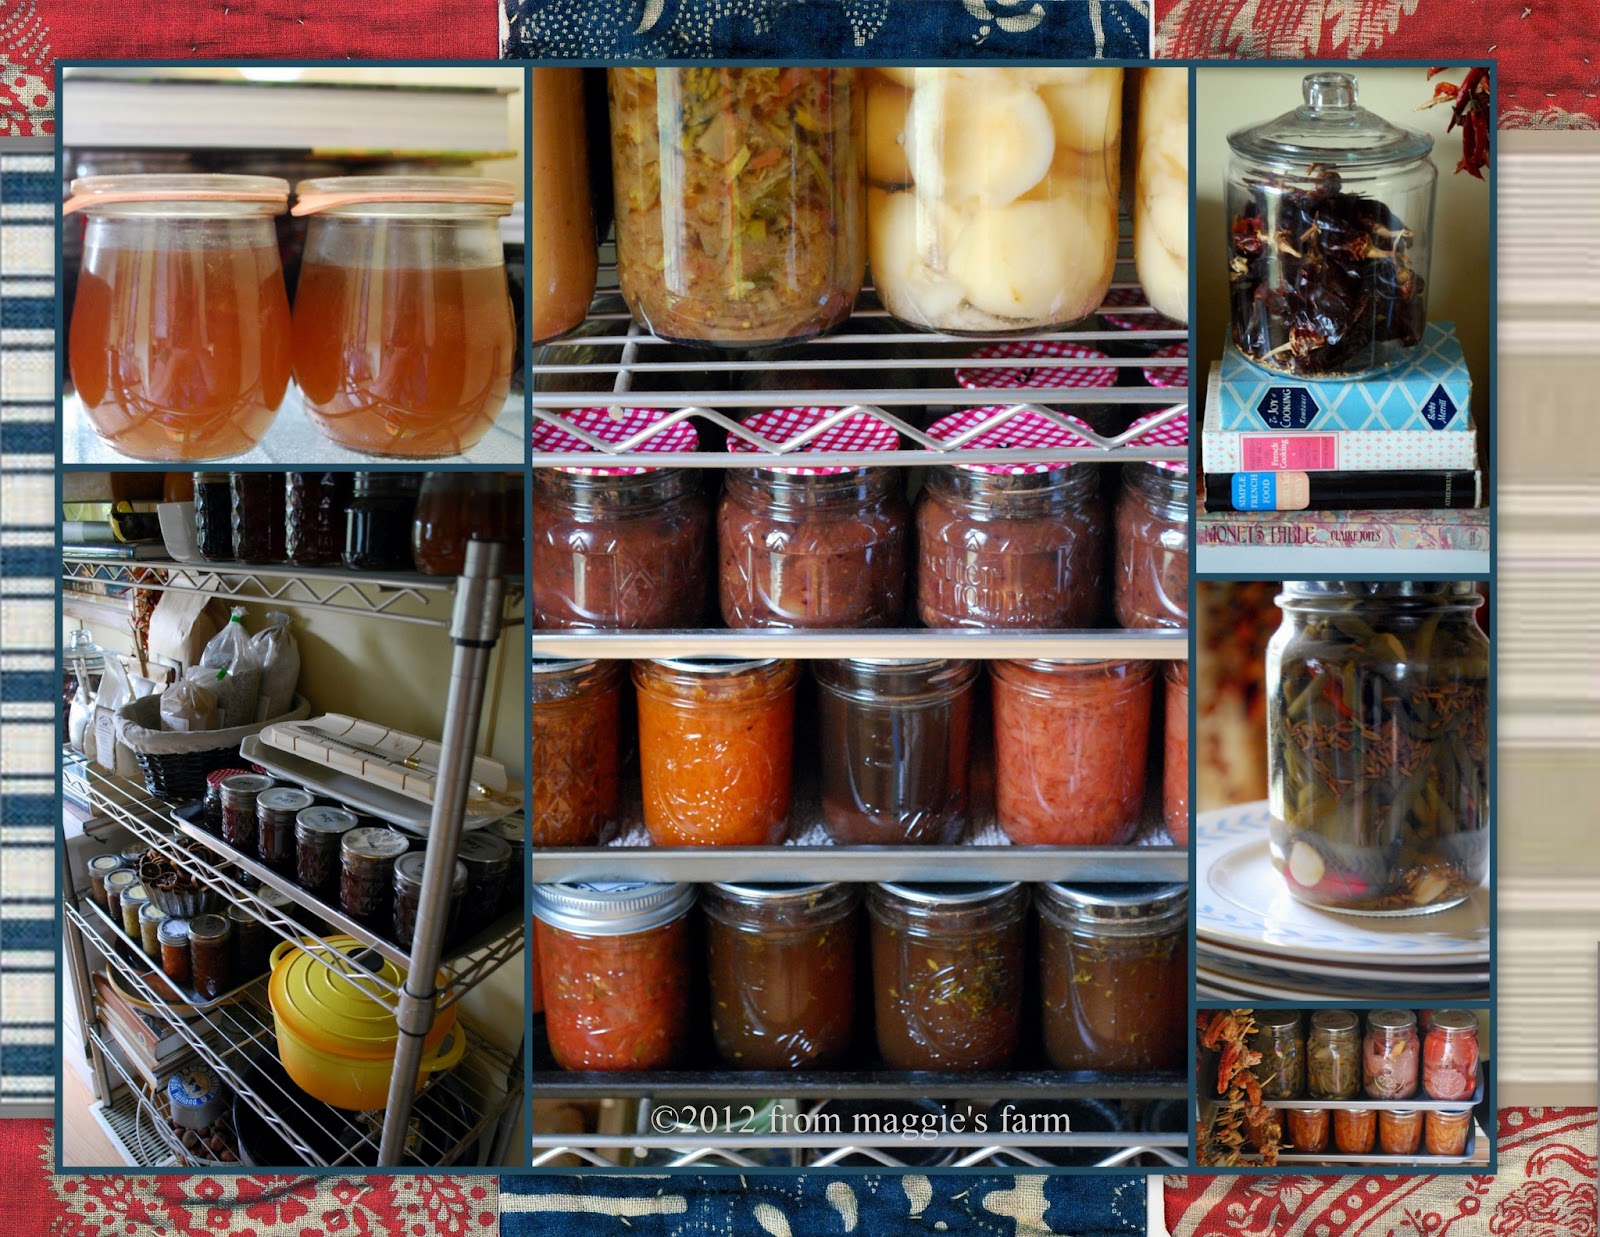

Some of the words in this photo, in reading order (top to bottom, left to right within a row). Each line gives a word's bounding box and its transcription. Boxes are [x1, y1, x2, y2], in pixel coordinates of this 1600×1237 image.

[1267, 399, 1279, 415] JOY
[1280, 388, 1292, 428] COOKING
[1427, 401, 1436, 421] Bobbs
[1437, 399, 1447, 424] Merrill
[1271, 442, 1279, 467] French
[1280, 439, 1290, 469] Cooking
[1238, 475, 1247, 508] SIMPLE
[1250, 474, 1258, 509] FRENCH
[1262, 478, 1271, 504] FOOD
[1331, 531, 1358, 542] CLAIRE
